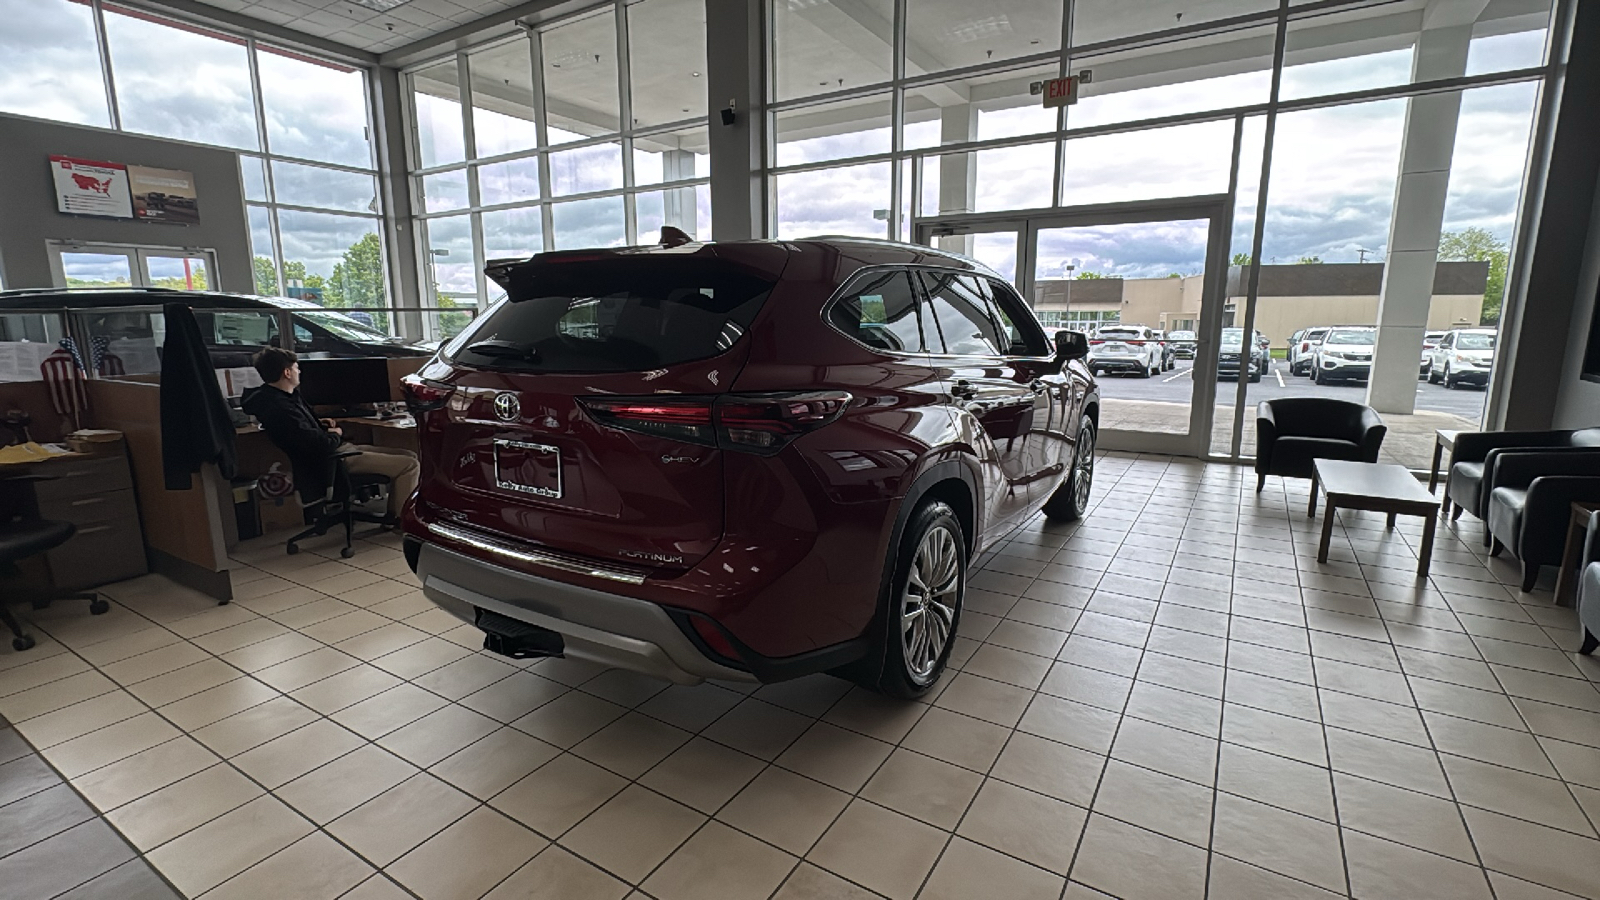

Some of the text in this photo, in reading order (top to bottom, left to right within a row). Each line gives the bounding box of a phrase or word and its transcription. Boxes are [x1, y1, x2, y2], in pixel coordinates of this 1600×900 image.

[1049, 77, 1072, 98] EXIT
[518, 485, 535, 493] Auto
[618, 548, 683, 564] PLATINUM
